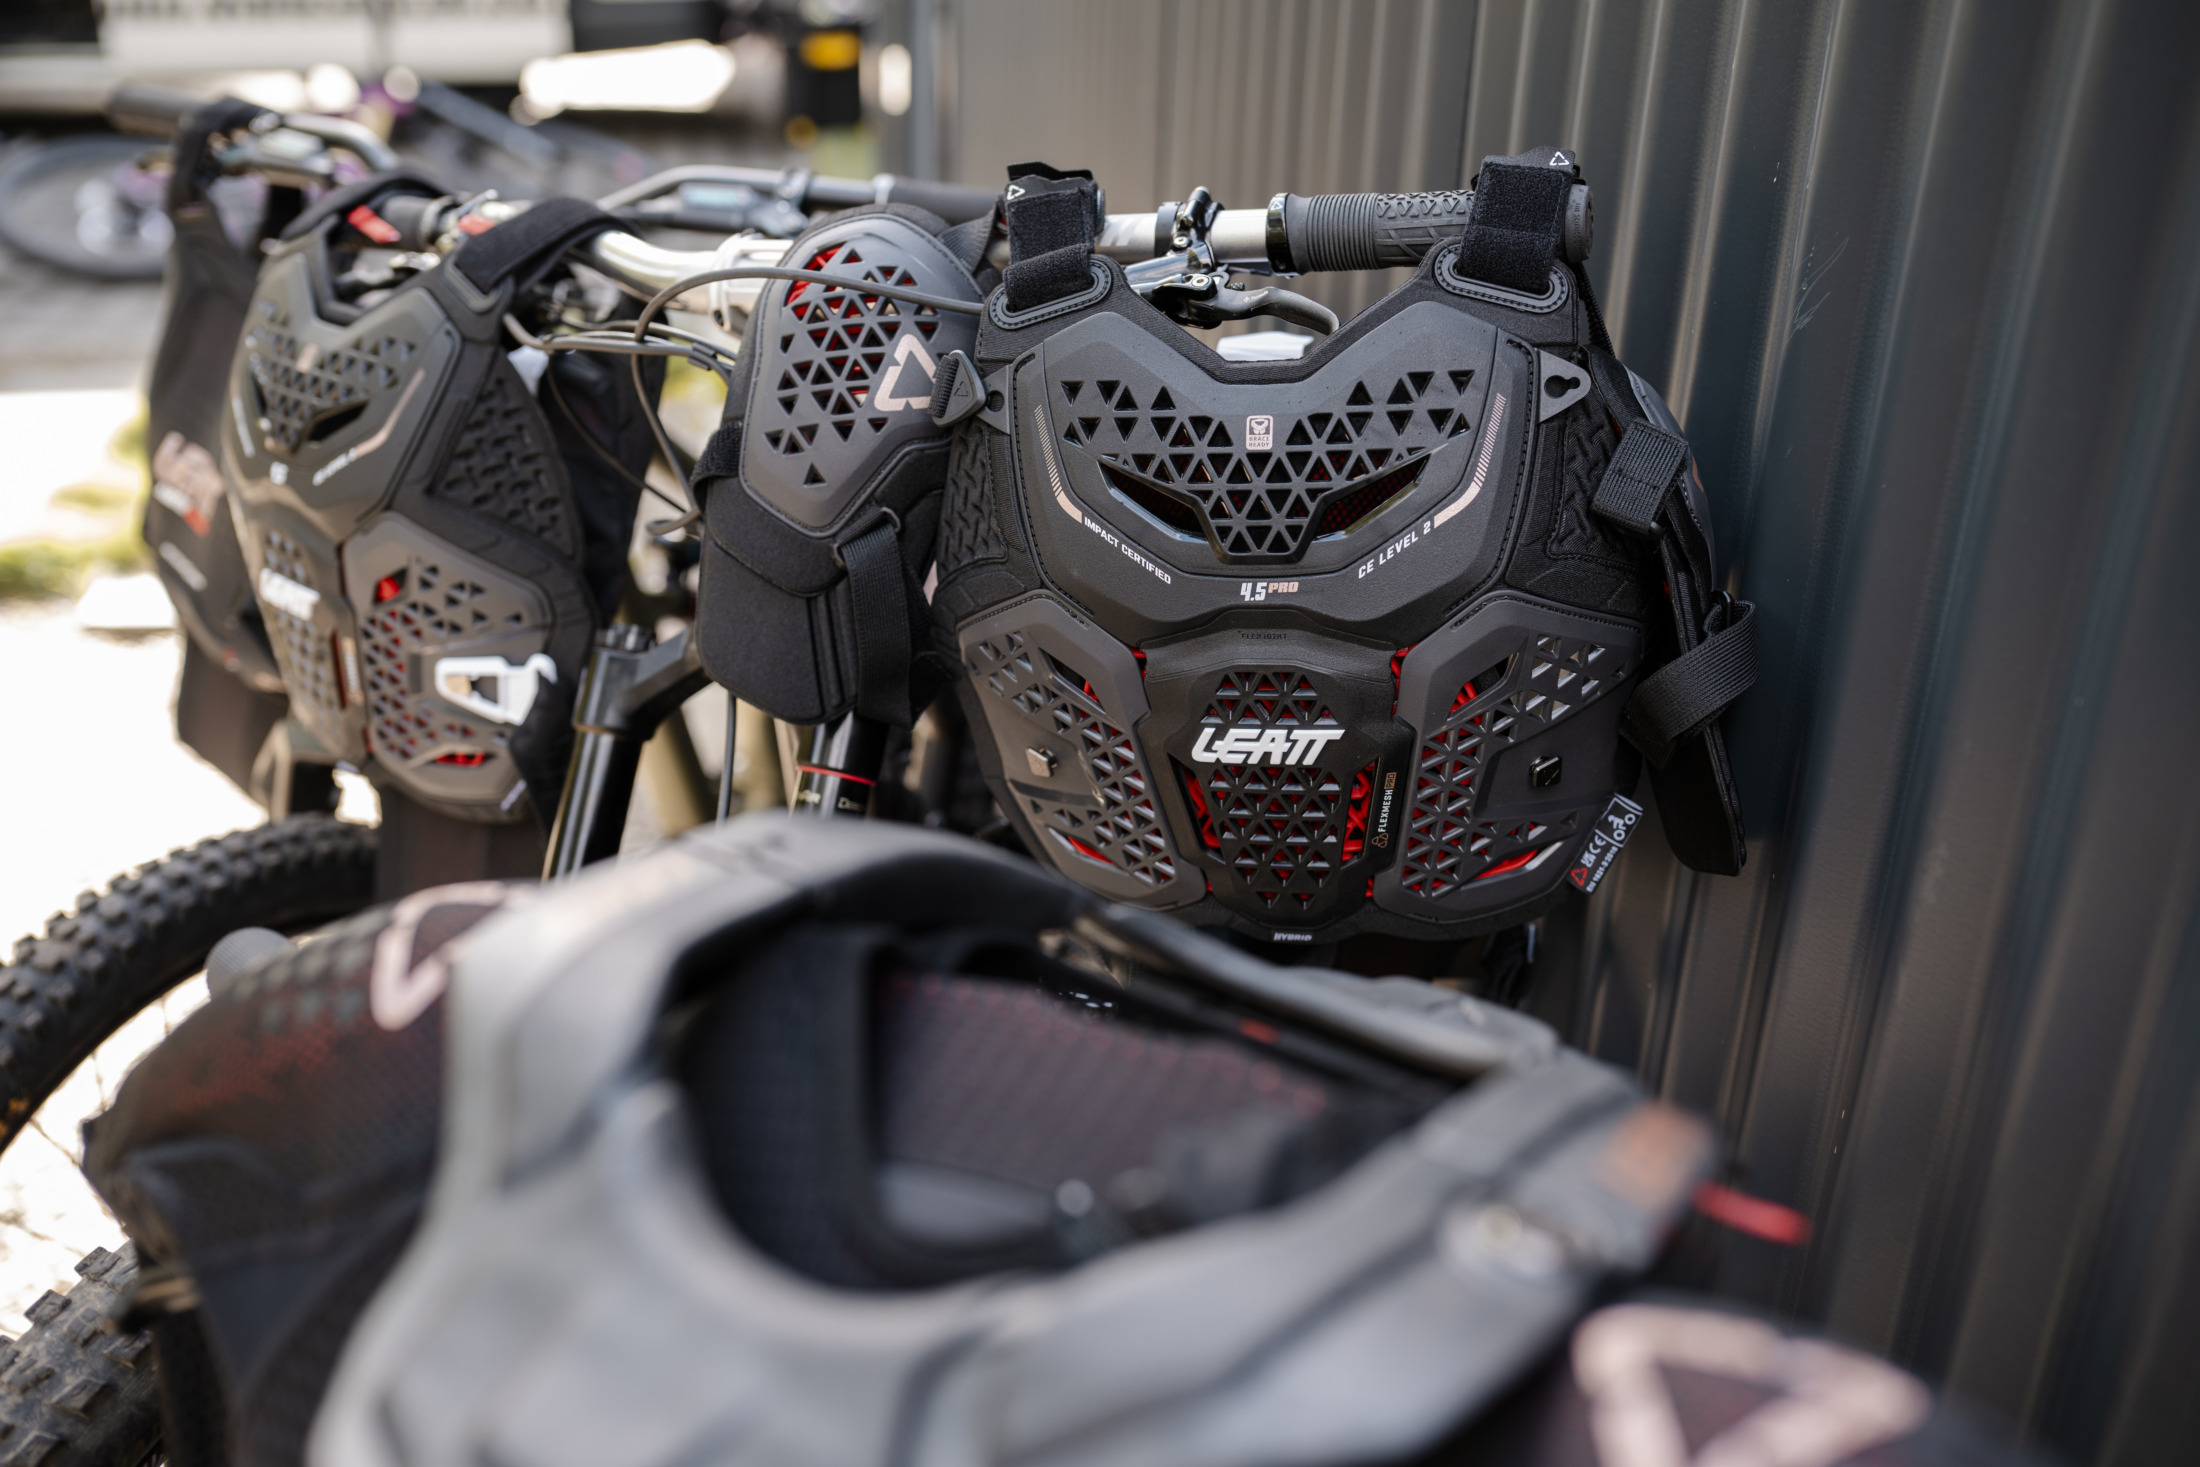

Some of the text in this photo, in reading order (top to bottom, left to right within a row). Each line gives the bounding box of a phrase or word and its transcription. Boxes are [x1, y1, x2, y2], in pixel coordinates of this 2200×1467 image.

[1084, 516, 1171, 585] IMPACT CERTIFIED
[1358, 520, 1431, 579] CE LEVEL 2
[1240, 581, 1299, 602] 4.5 PRO
[1191, 727, 1346, 766] LEATT
[1378, 773, 1396, 833] FLEXMESH PRO
[1273, 932, 1313, 942] HYBRID
